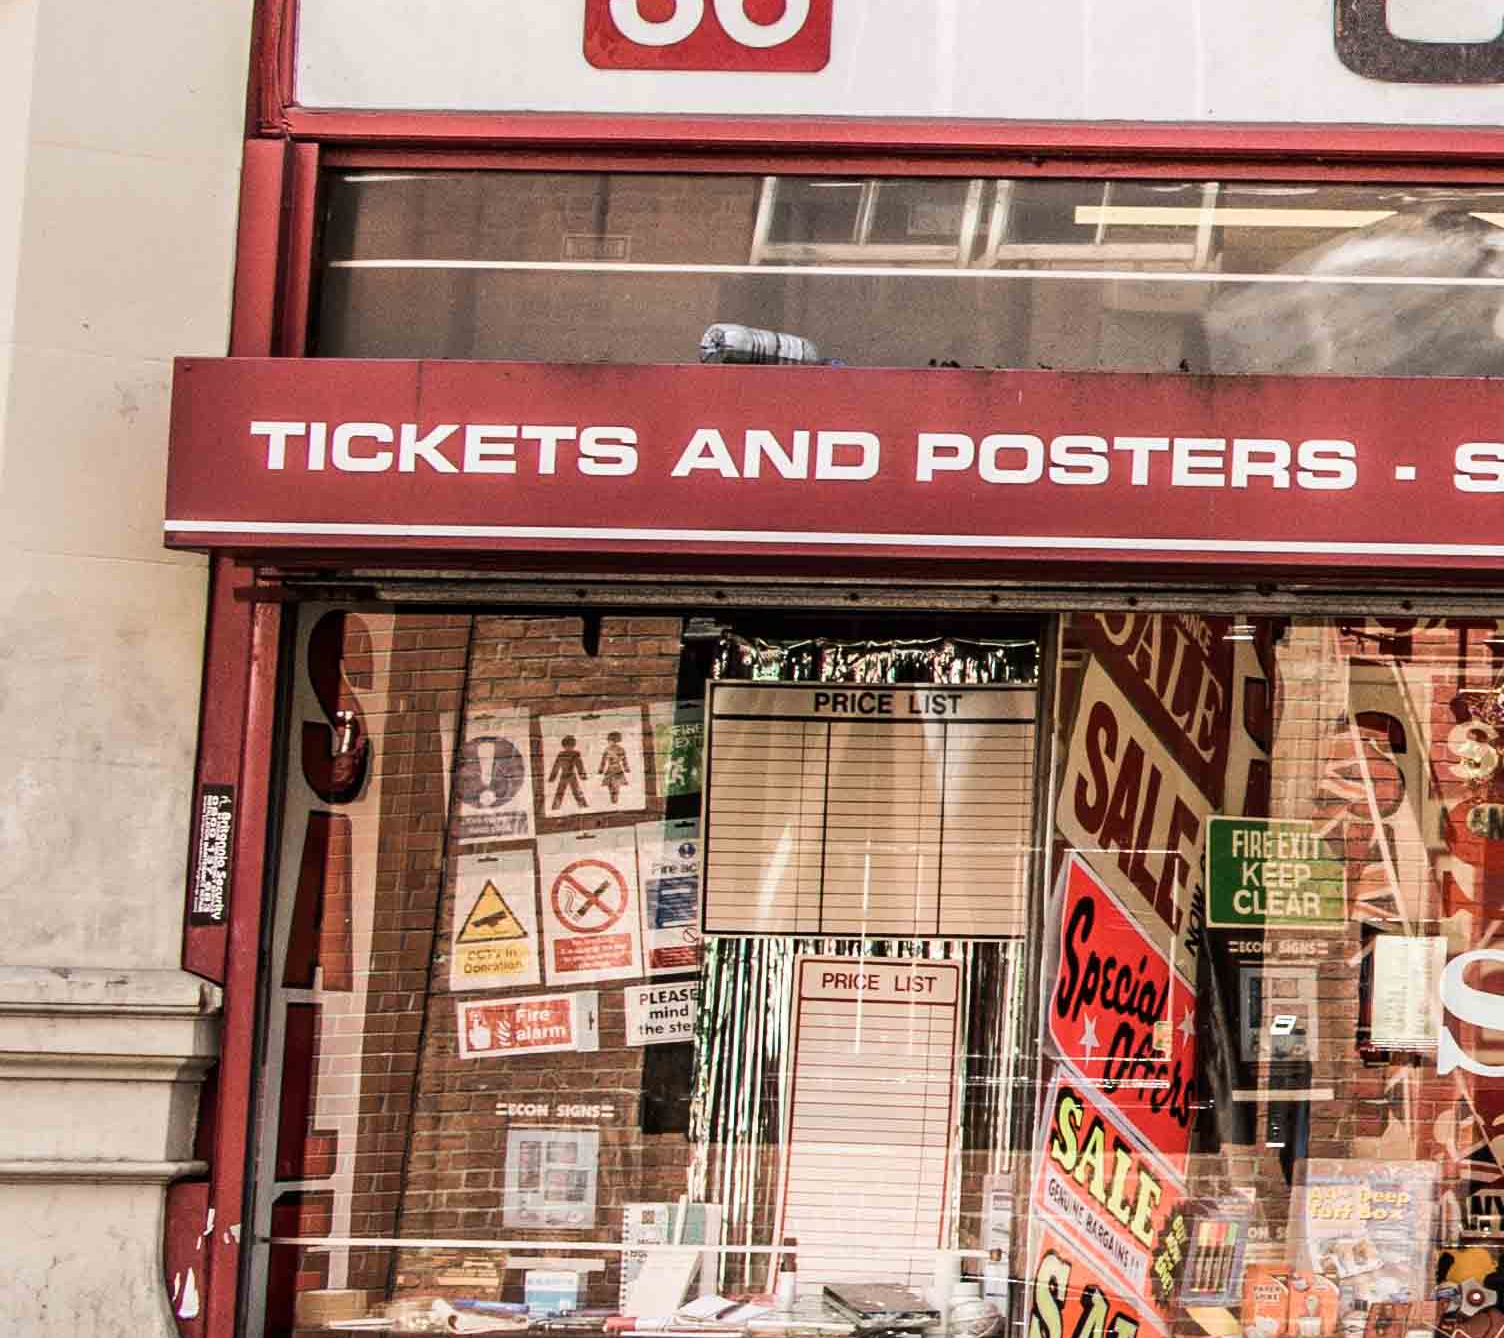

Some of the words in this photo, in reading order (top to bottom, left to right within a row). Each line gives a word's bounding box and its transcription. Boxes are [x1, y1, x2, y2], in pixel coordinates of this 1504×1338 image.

[249, 419, 639, 477] TICKETS
[670, 427, 881, 481] AND
[914, 432, 1358, 492] POSTERS
[813, 692, 893, 715] PRICE
[908, 694, 963, 716] LIST
[1072, 699, 1203, 937] SALE
[1232, 829, 1272, 859] FIRE
[1278, 831, 1321, 860] EXIT
[1241, 861, 1312, 889] KEEP
[1232, 889, 1321, 917] CLEAR
[1056, 896, 1171, 1023] Special
[821, 971, 881, 992] PRICE
[893, 973, 938, 994] LIST
[639, 988, 701, 1005] PLEASE
[515, 1008, 551, 1023] Fire
[649, 1005, 689, 1021] mind
[514, 1022, 567, 1041] alarm
[640, 1023, 664, 1037] the
[556, 1103, 601, 1118] SIGNS
[1050, 1086, 1164, 1250] SALE
